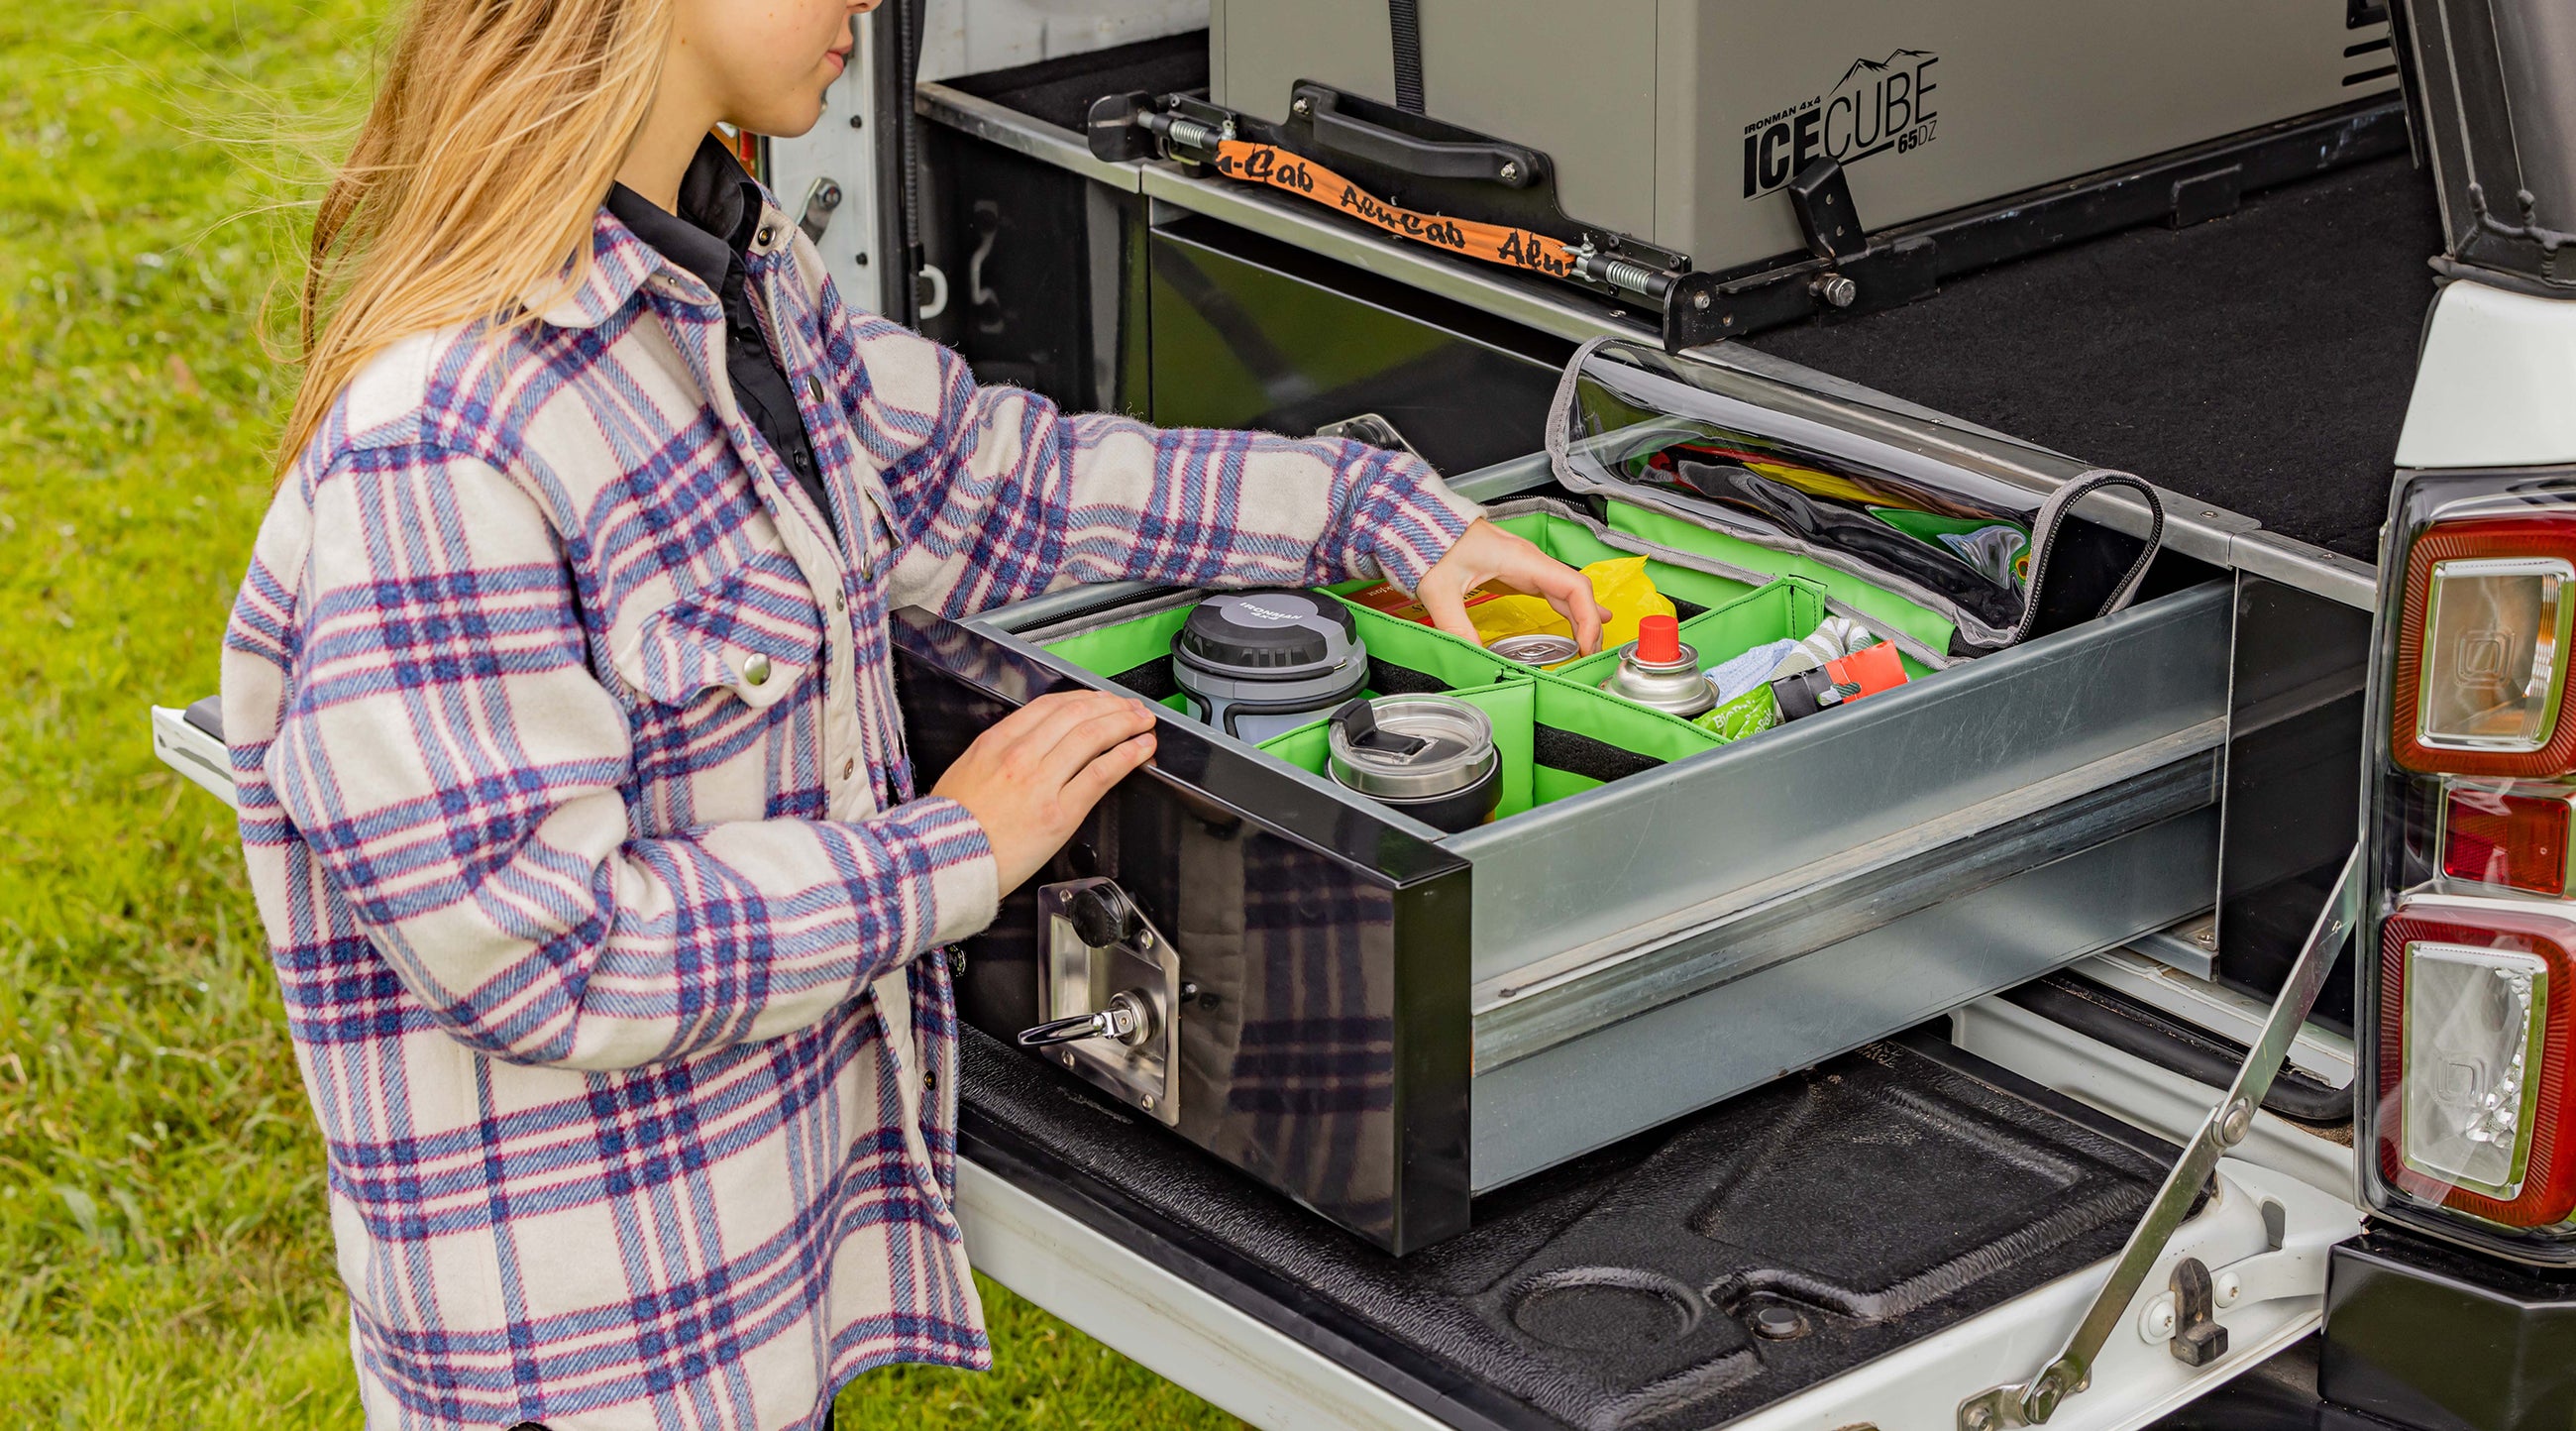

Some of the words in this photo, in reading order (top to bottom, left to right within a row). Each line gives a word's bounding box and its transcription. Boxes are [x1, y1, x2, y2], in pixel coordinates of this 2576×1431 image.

[1745, 105, 1796, 135] IRONMAN
[1799, 95, 1821, 111] 4x4
[1897, 120, 1937, 155] 65DZ
[1239, 602, 1303, 620] IRONMAN
